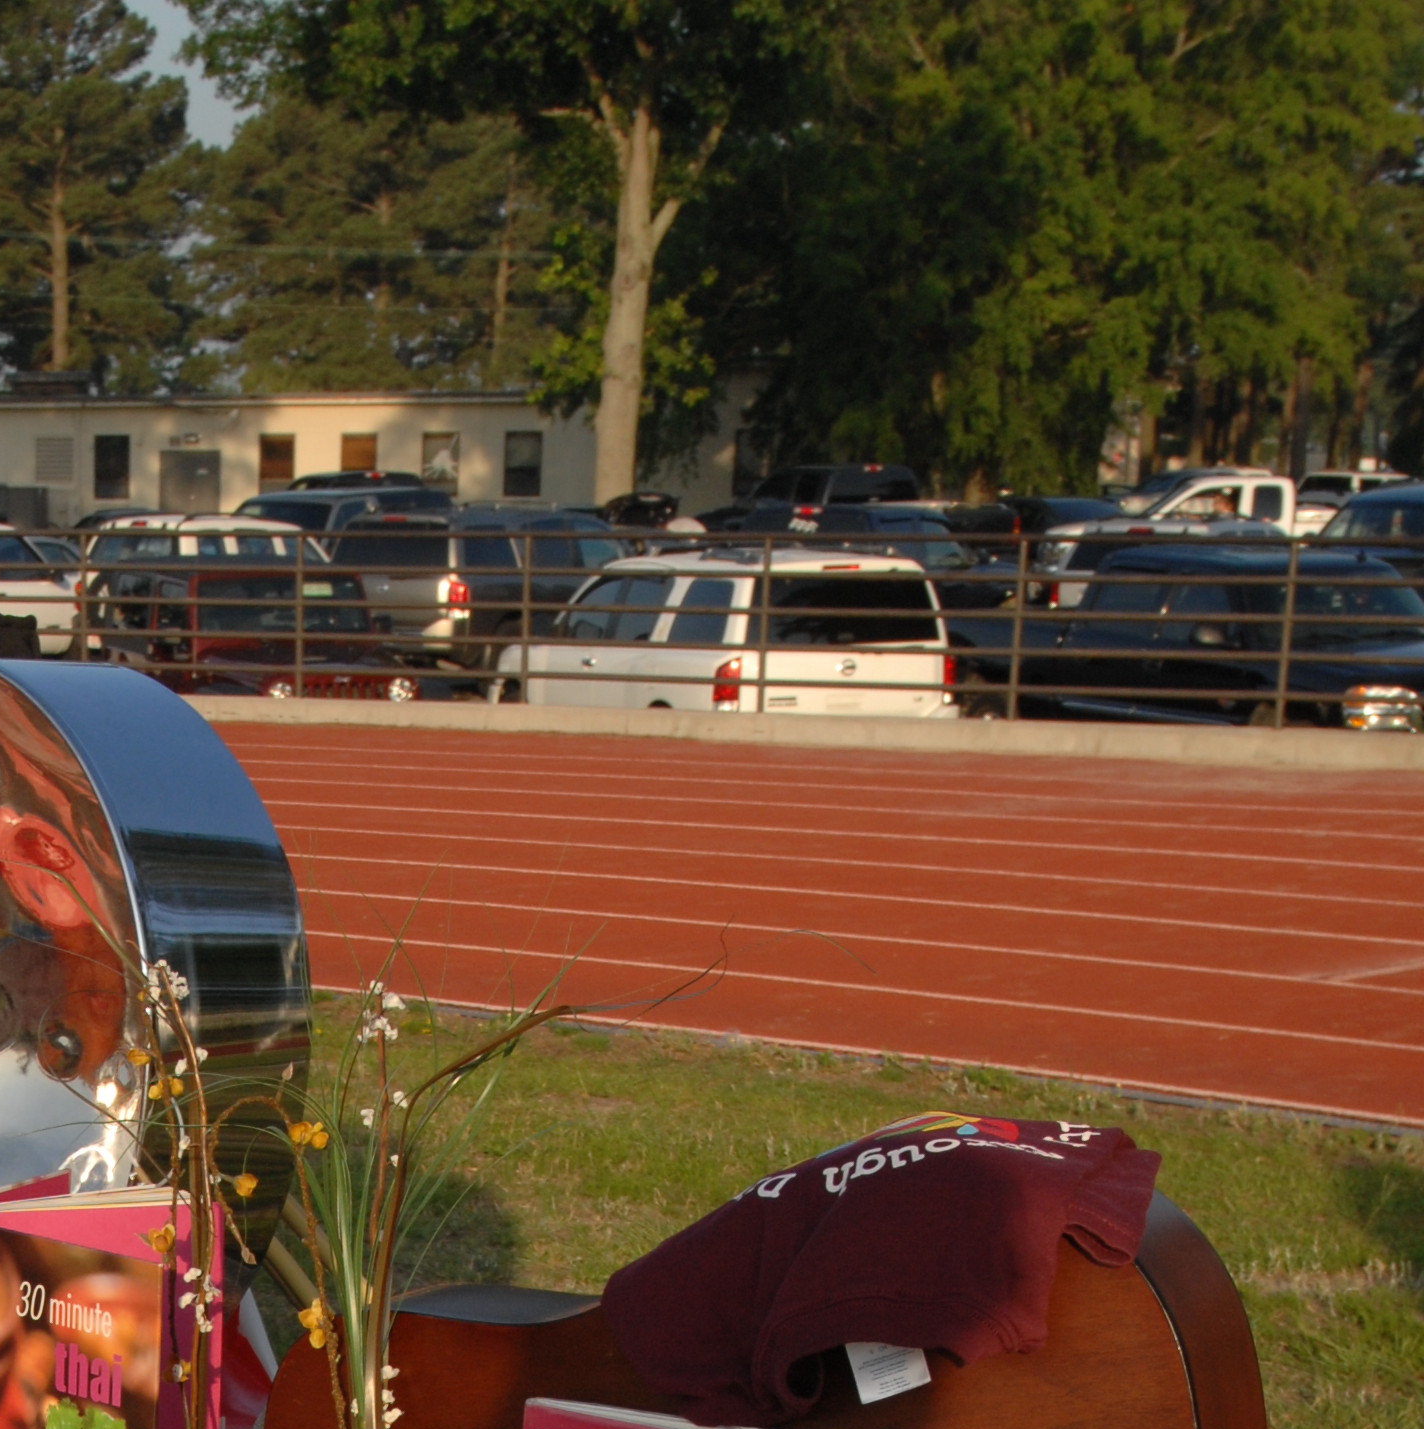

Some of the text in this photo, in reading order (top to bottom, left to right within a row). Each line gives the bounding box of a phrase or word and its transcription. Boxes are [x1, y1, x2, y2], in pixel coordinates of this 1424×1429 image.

[16, 1280, 112, 1338] 30 minute
[55, 1341, 122, 1408] thai
